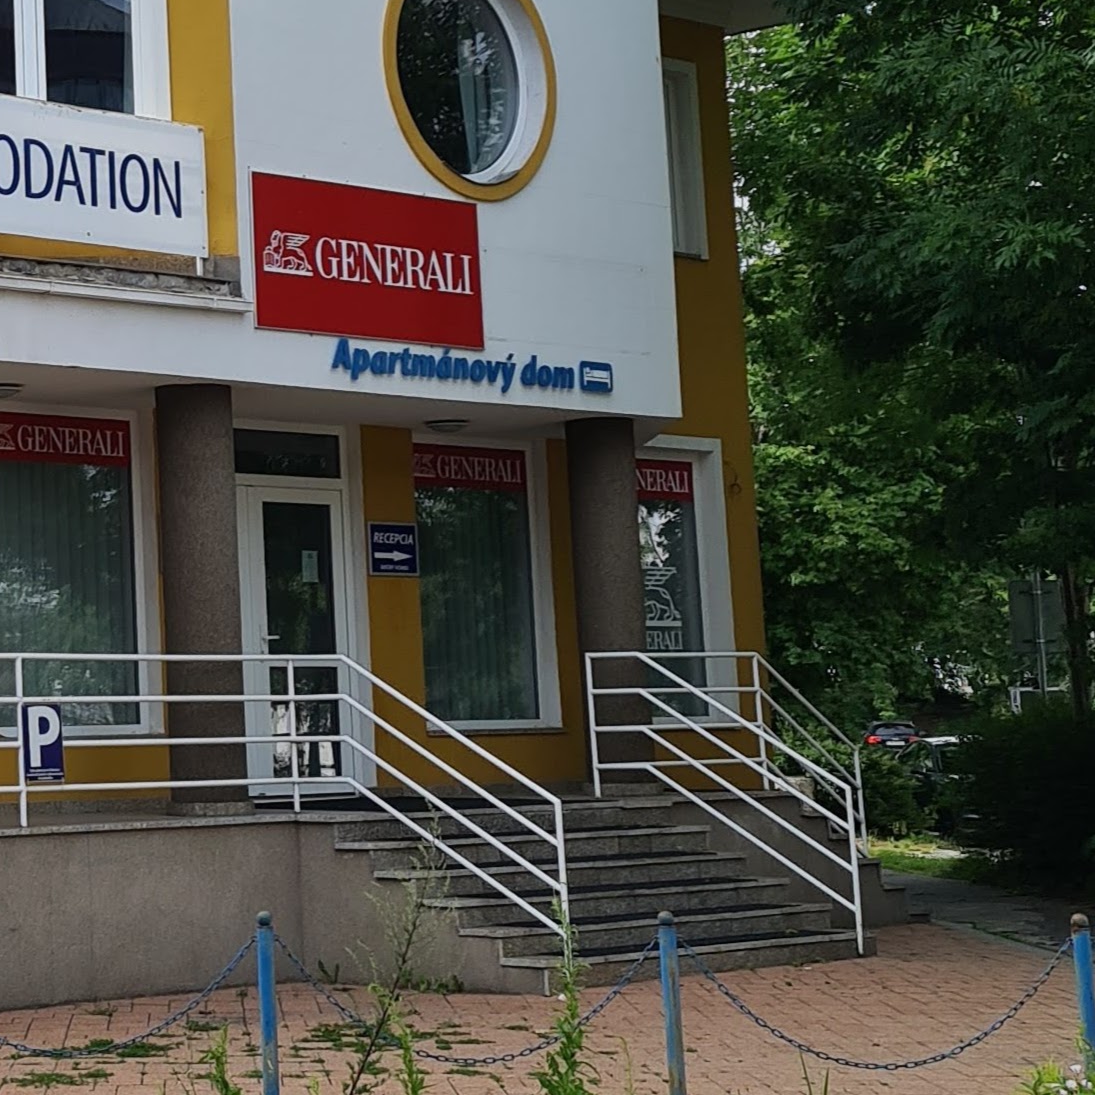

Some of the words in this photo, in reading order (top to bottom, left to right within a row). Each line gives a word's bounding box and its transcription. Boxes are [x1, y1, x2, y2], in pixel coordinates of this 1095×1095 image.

[315, 236, 474, 295] GENERALI
[331, 337, 516, 394] Apartmánový
[520, 355, 575, 390] dom
[17, 424, 126, 458] GENERALI
[436, 453, 523, 484] GENERALI
[635, 468, 690, 494] NERALI
[373, 531, 414, 545] RECEPCIA
[646, 630, 684, 650] ERALI
[27, 705, 61, 768] P
